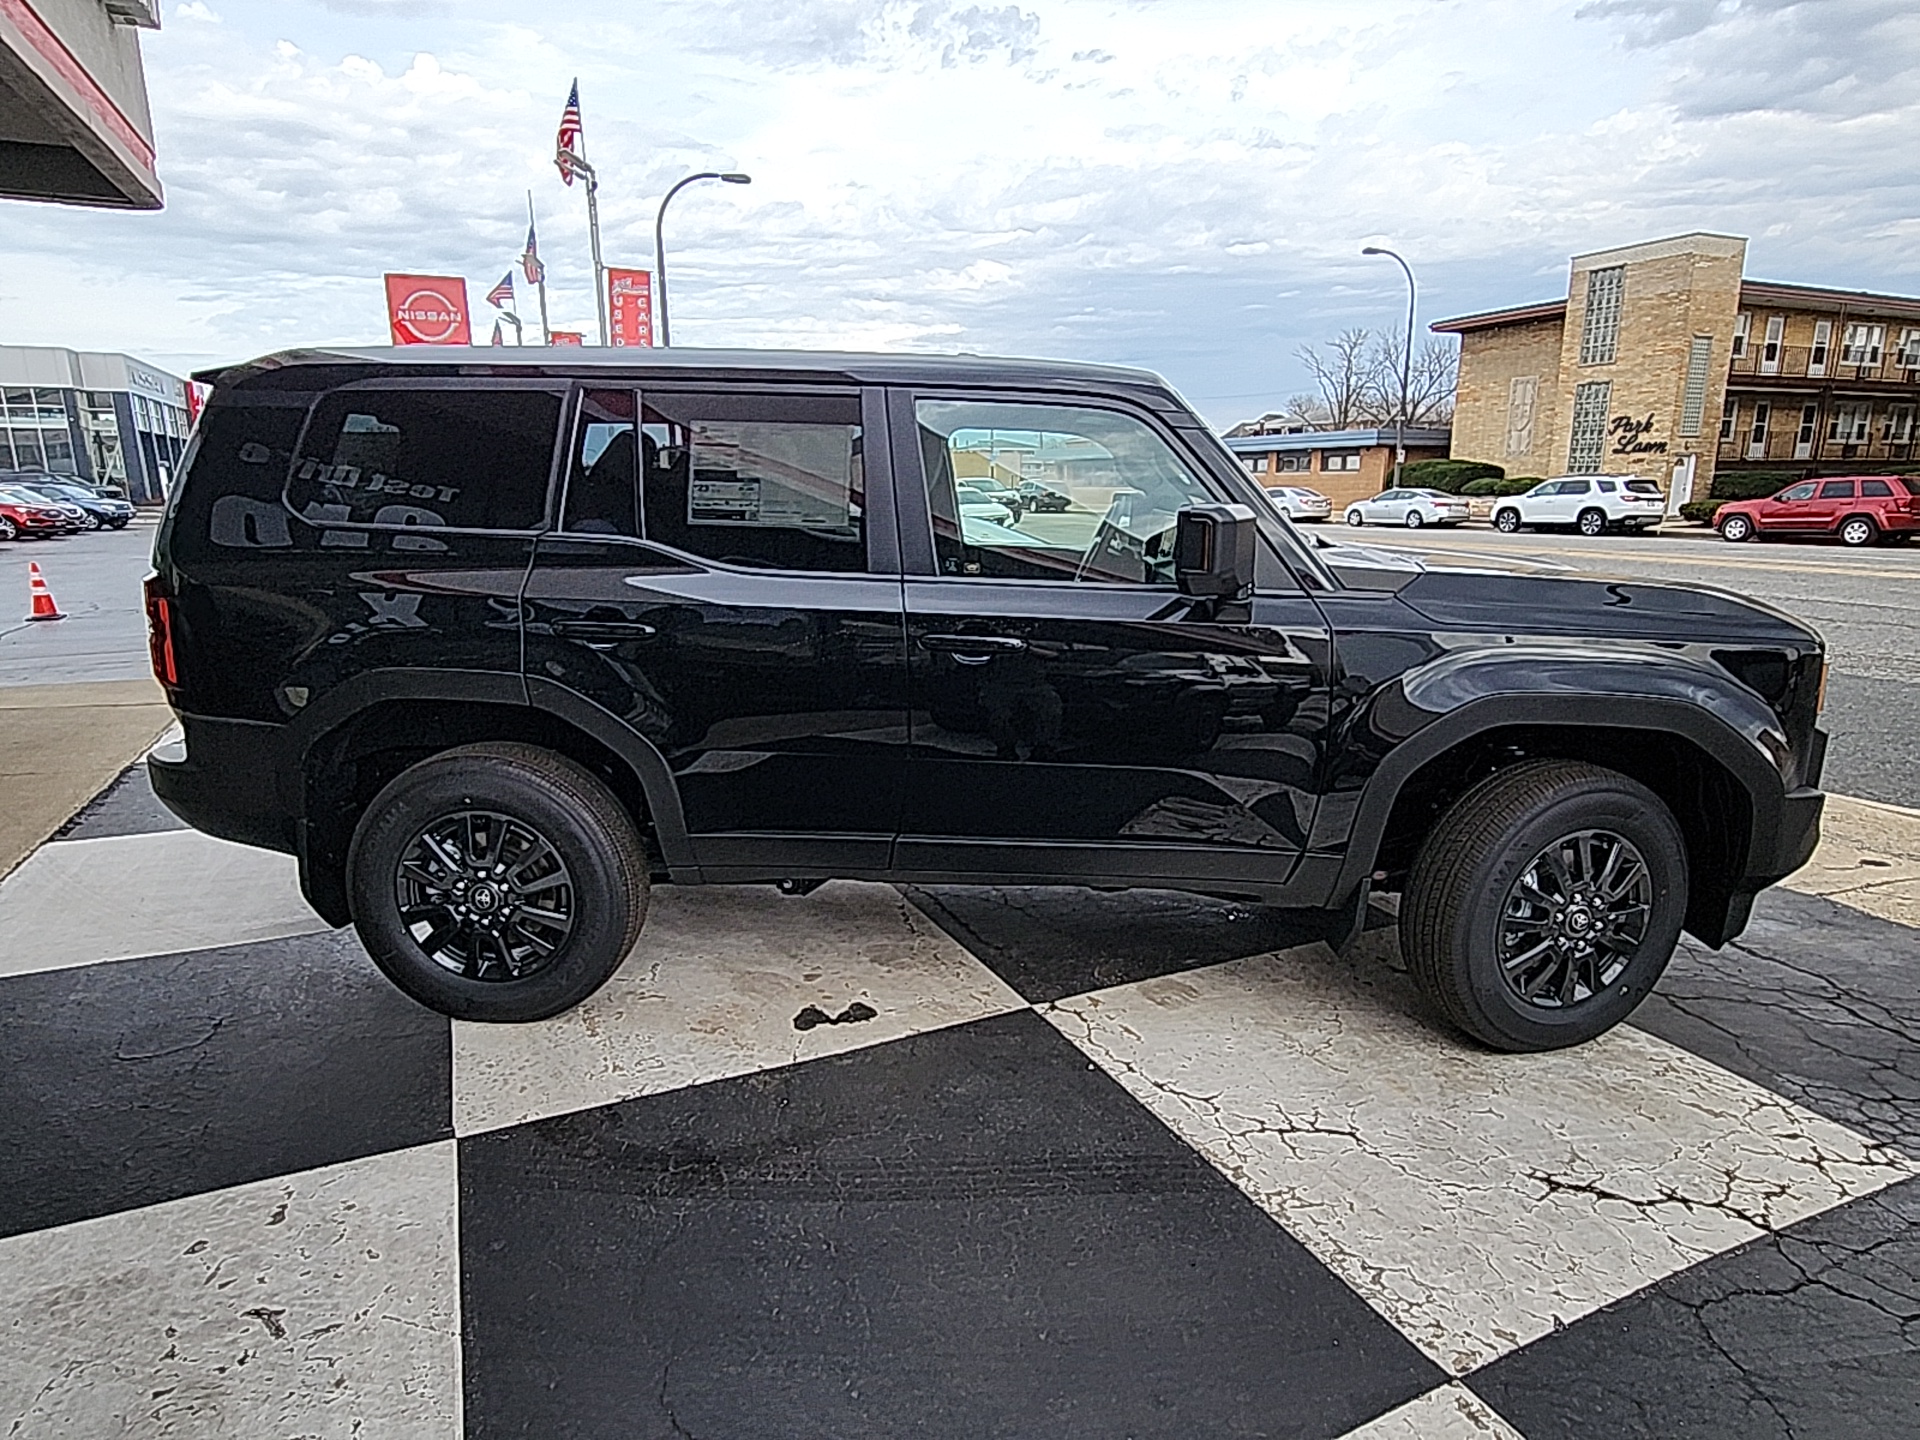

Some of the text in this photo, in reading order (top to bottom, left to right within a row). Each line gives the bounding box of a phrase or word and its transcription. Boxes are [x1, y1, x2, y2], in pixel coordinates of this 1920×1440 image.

[398, 310, 462, 322] NISSAN
[612, 295, 625, 347] USED
[636, 297, 648, 347] CARS
[1607, 412, 1656, 436] Park
[1611, 433, 1669, 455] Lawn
